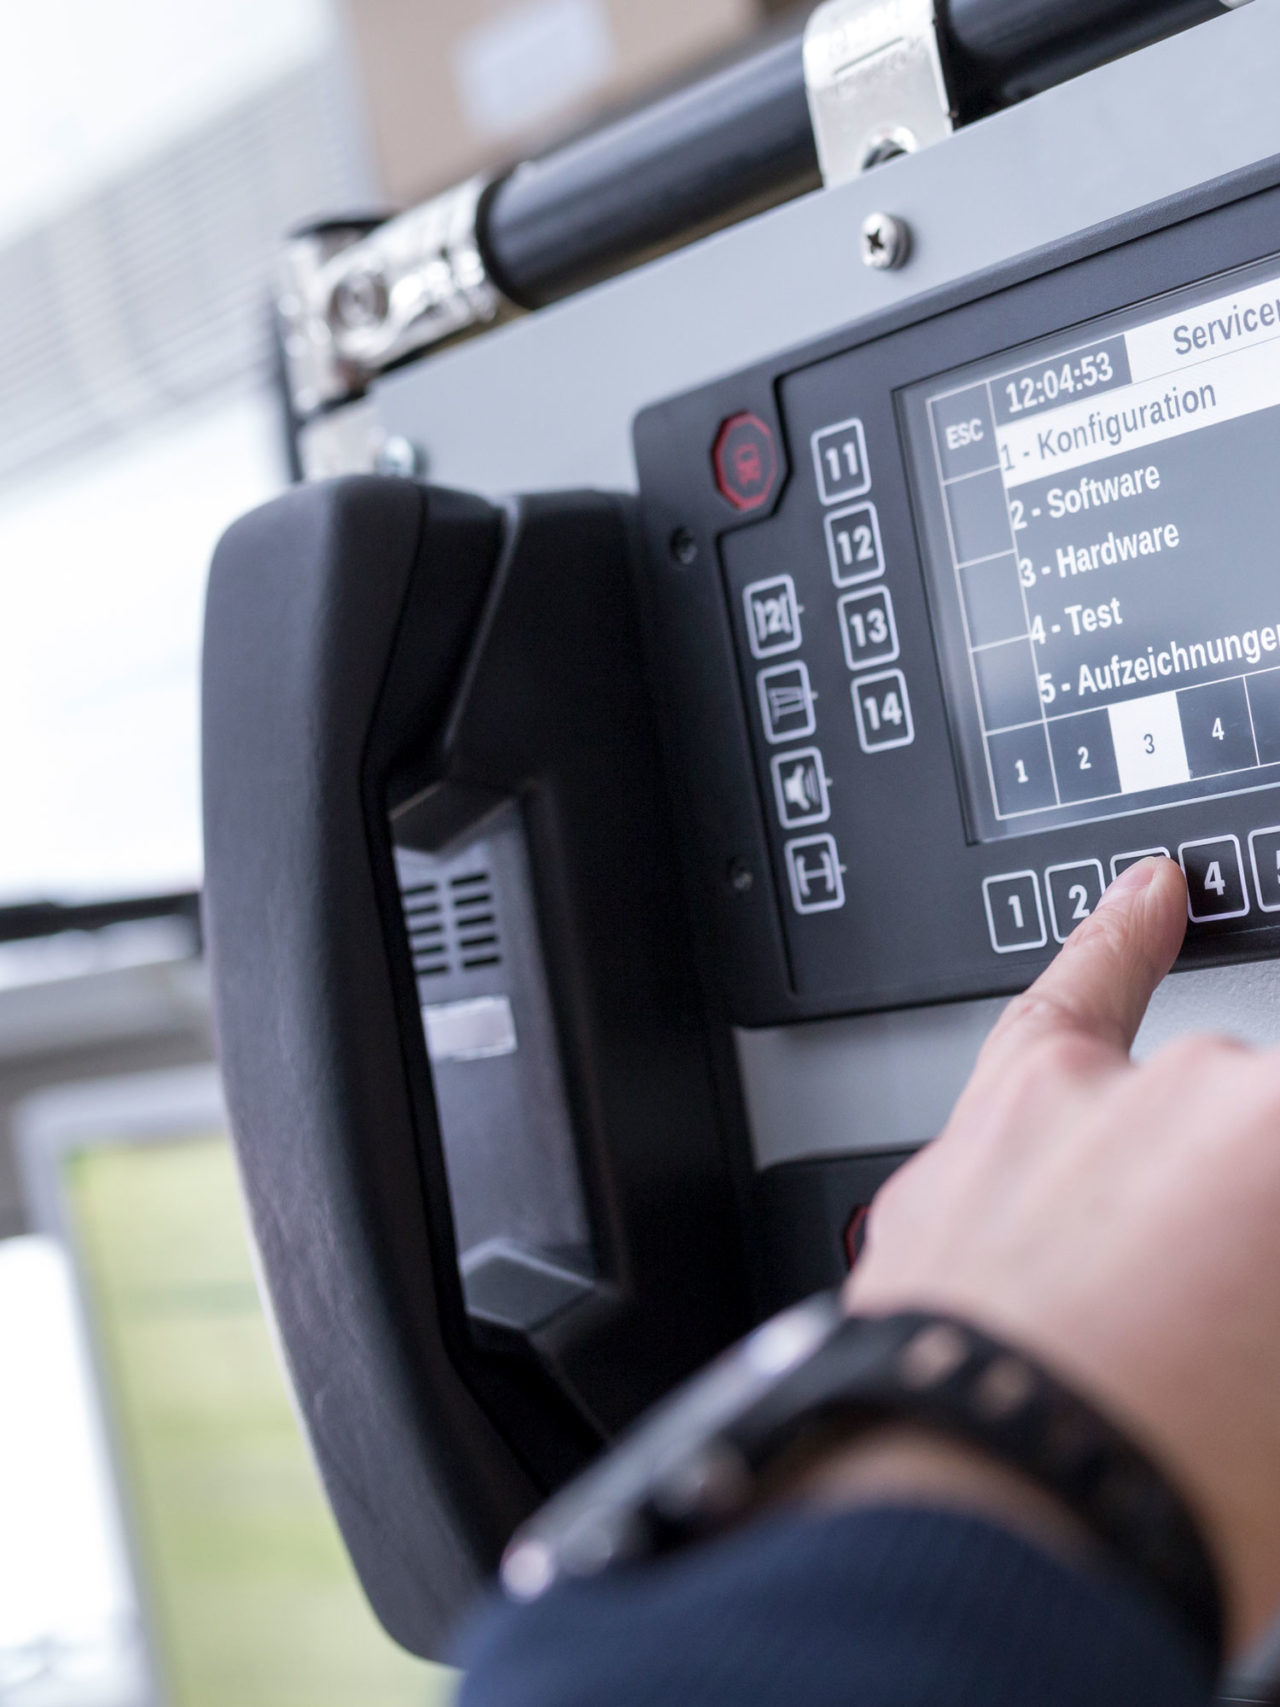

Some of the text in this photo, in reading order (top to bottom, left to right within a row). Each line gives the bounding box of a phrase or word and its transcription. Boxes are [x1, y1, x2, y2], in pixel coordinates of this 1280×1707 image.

[1006, 351, 1114, 414] 12:04:53
[945, 418, 984, 451] ESC
[1001, 443, 1016, 472] 1
[1037, 383, 1217, 461] Konfiguration
[825, 441, 858, 482] 11
[1009, 500, 1027, 531] 2
[1047, 465, 1161, 519] Software
[837, 525, 874, 566] 12
[1019, 557, 1037, 588] 3
[1055, 523, 1180, 578] Hardware
[850, 608, 888, 648] 13
[1030, 614, 1046, 645] 4
[1063, 596, 1123, 636] Test
[864, 692, 902, 731] 14
[1038, 672, 1056, 704] 5
[1015, 759, 1028, 784] 1
[1077, 746, 1092, 770] 2
[1143, 732, 1156, 755] 3
[1211, 717, 1225, 741] 4
[1007, 894, 1025, 929] 1
[1068, 884, 1090, 920] 2
[1203, 860, 1225, 896] 4
